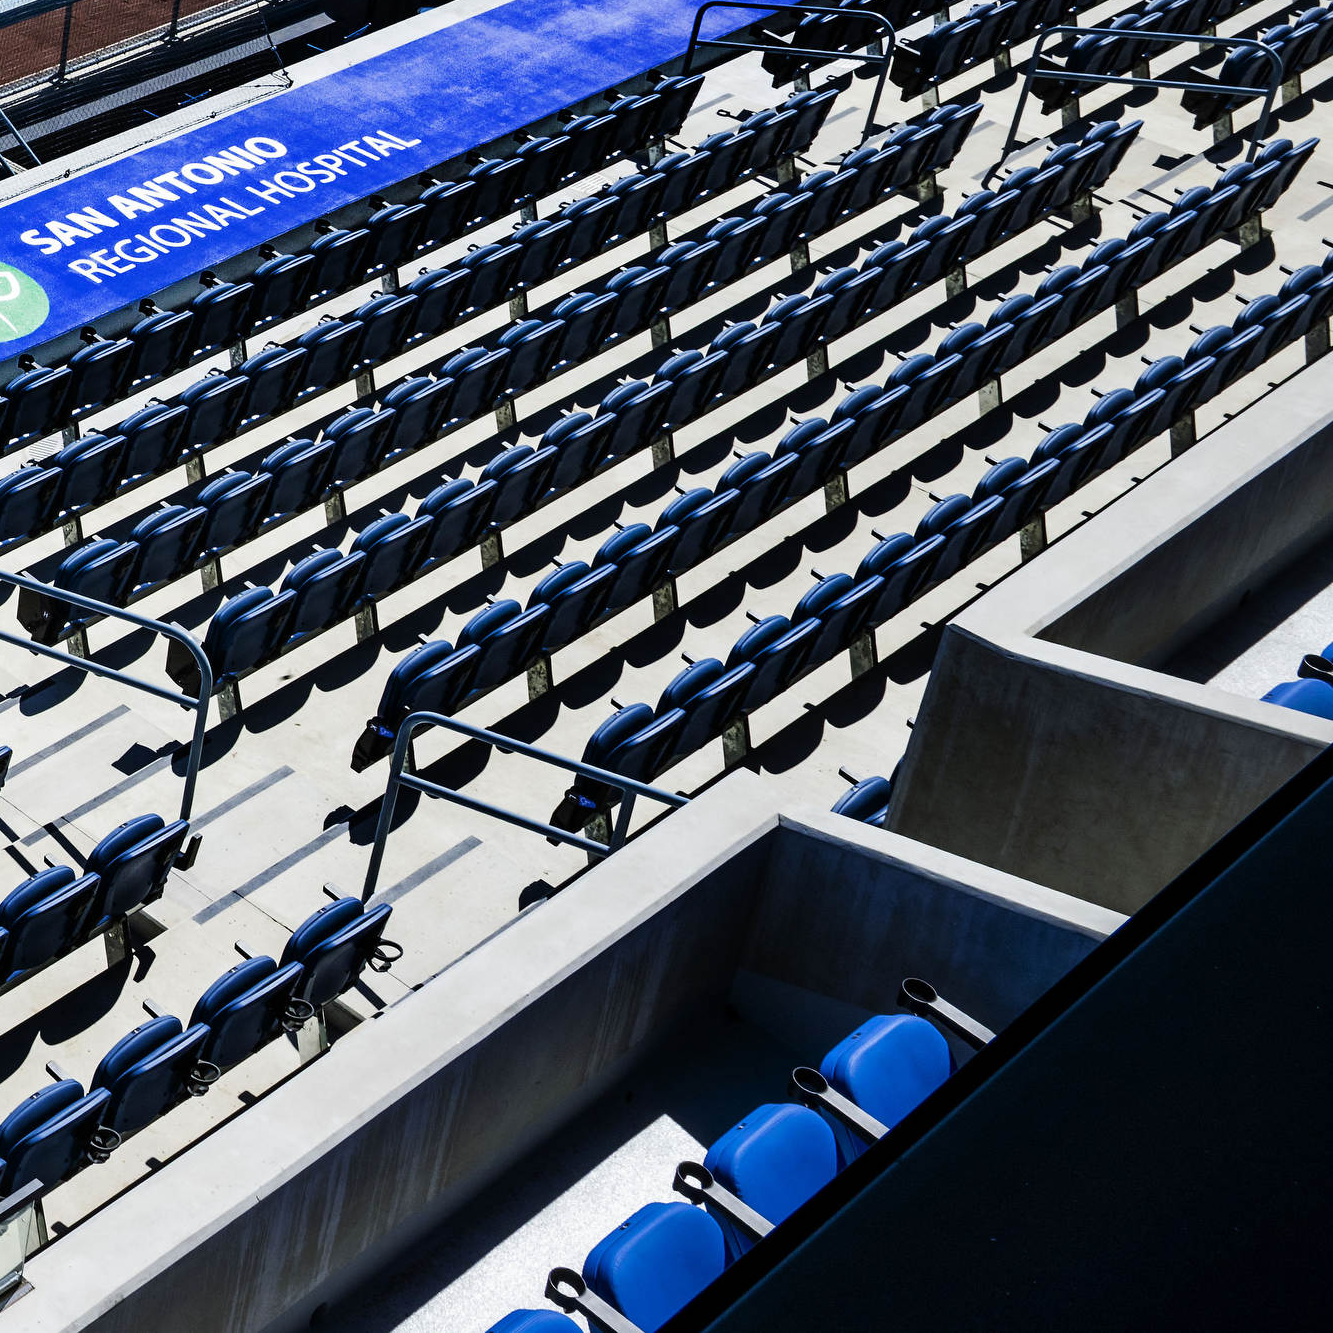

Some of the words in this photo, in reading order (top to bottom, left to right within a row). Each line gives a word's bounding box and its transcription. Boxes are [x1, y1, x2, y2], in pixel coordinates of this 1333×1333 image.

[20, 205, 115, 255] SAN
[109, 136, 288, 221] ANTONIO
[68, 197, 263, 284] REGIONAL
[260, 130, 422, 209] HOSPITAL
